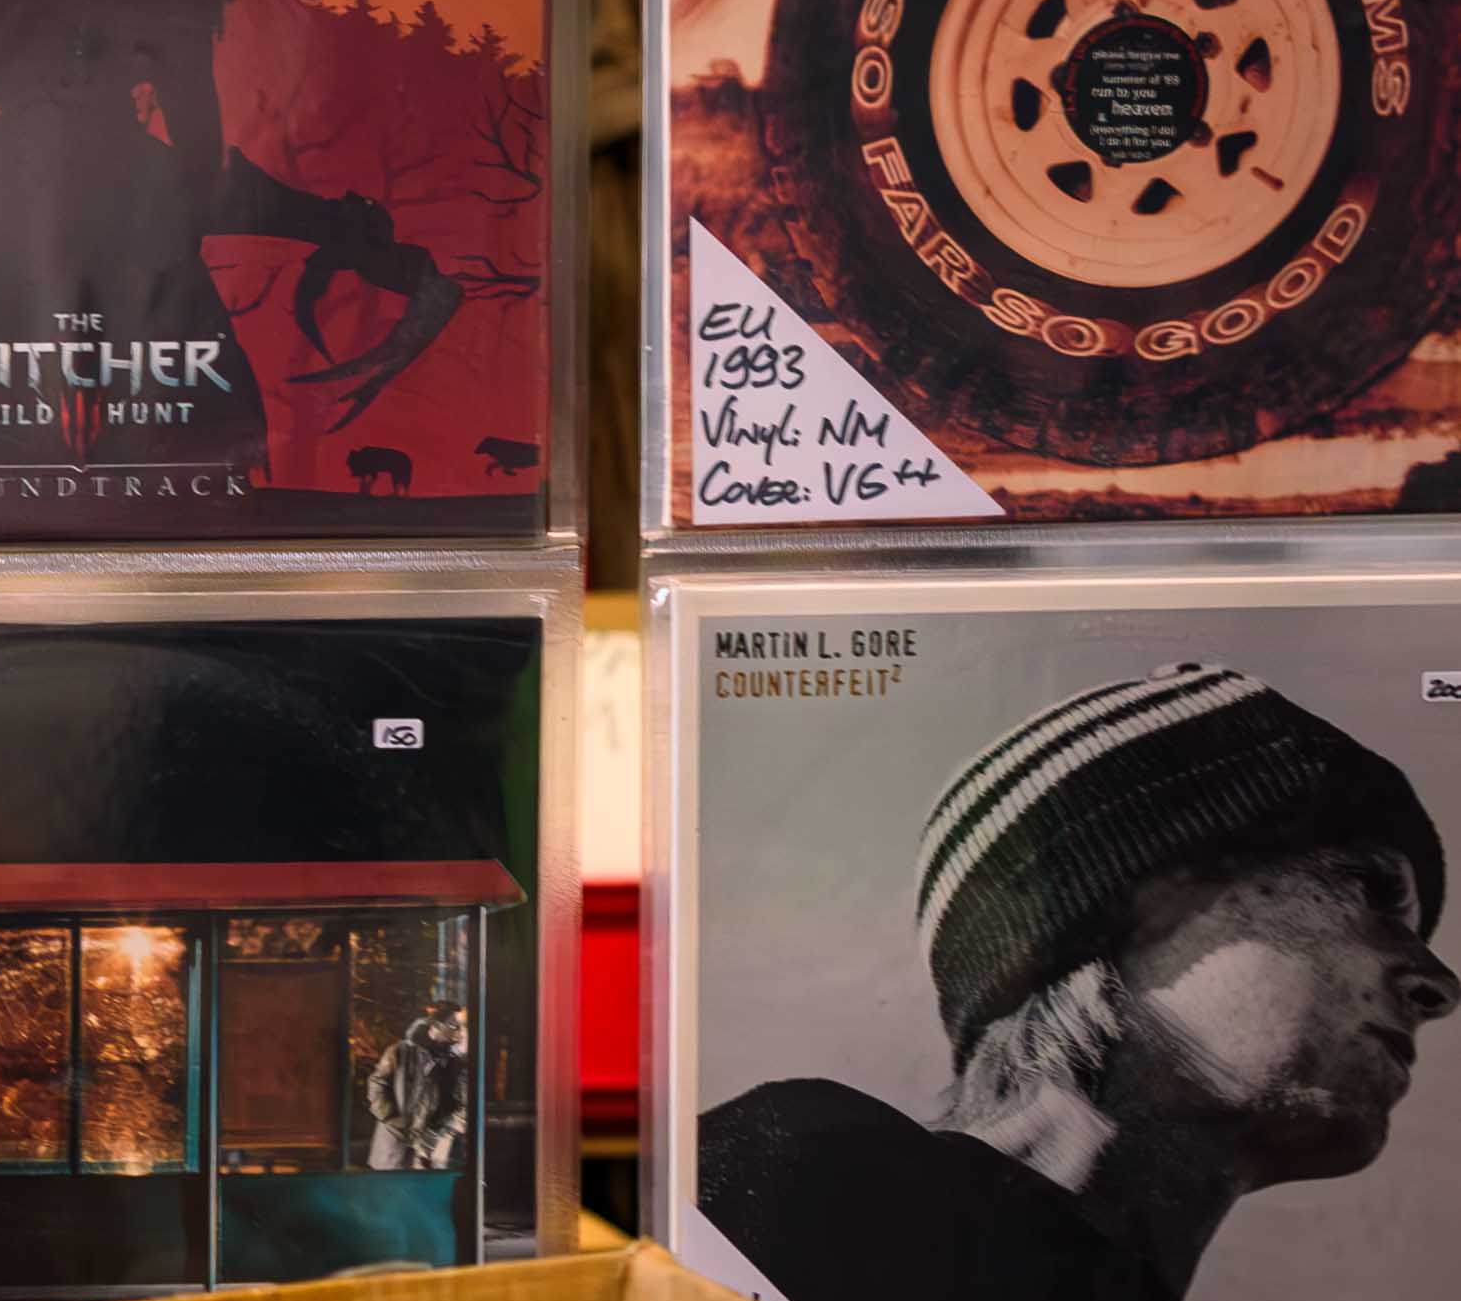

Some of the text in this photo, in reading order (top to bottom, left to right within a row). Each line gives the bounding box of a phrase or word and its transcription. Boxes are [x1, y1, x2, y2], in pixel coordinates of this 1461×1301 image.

[861, 135, 977, 295] FAR
[984, 288, 1105, 359] SO
[1133, 200, 1371, 364] GOOD
[52, 312, 105, 332] THE
[698, 302, 778, 343] EU
[702, 343, 808, 391] 1993
[106, 402, 196, 425] HUNT
[818, 413, 891, 451] NM
[715, 629, 918, 659] MARTIN L. GORE
